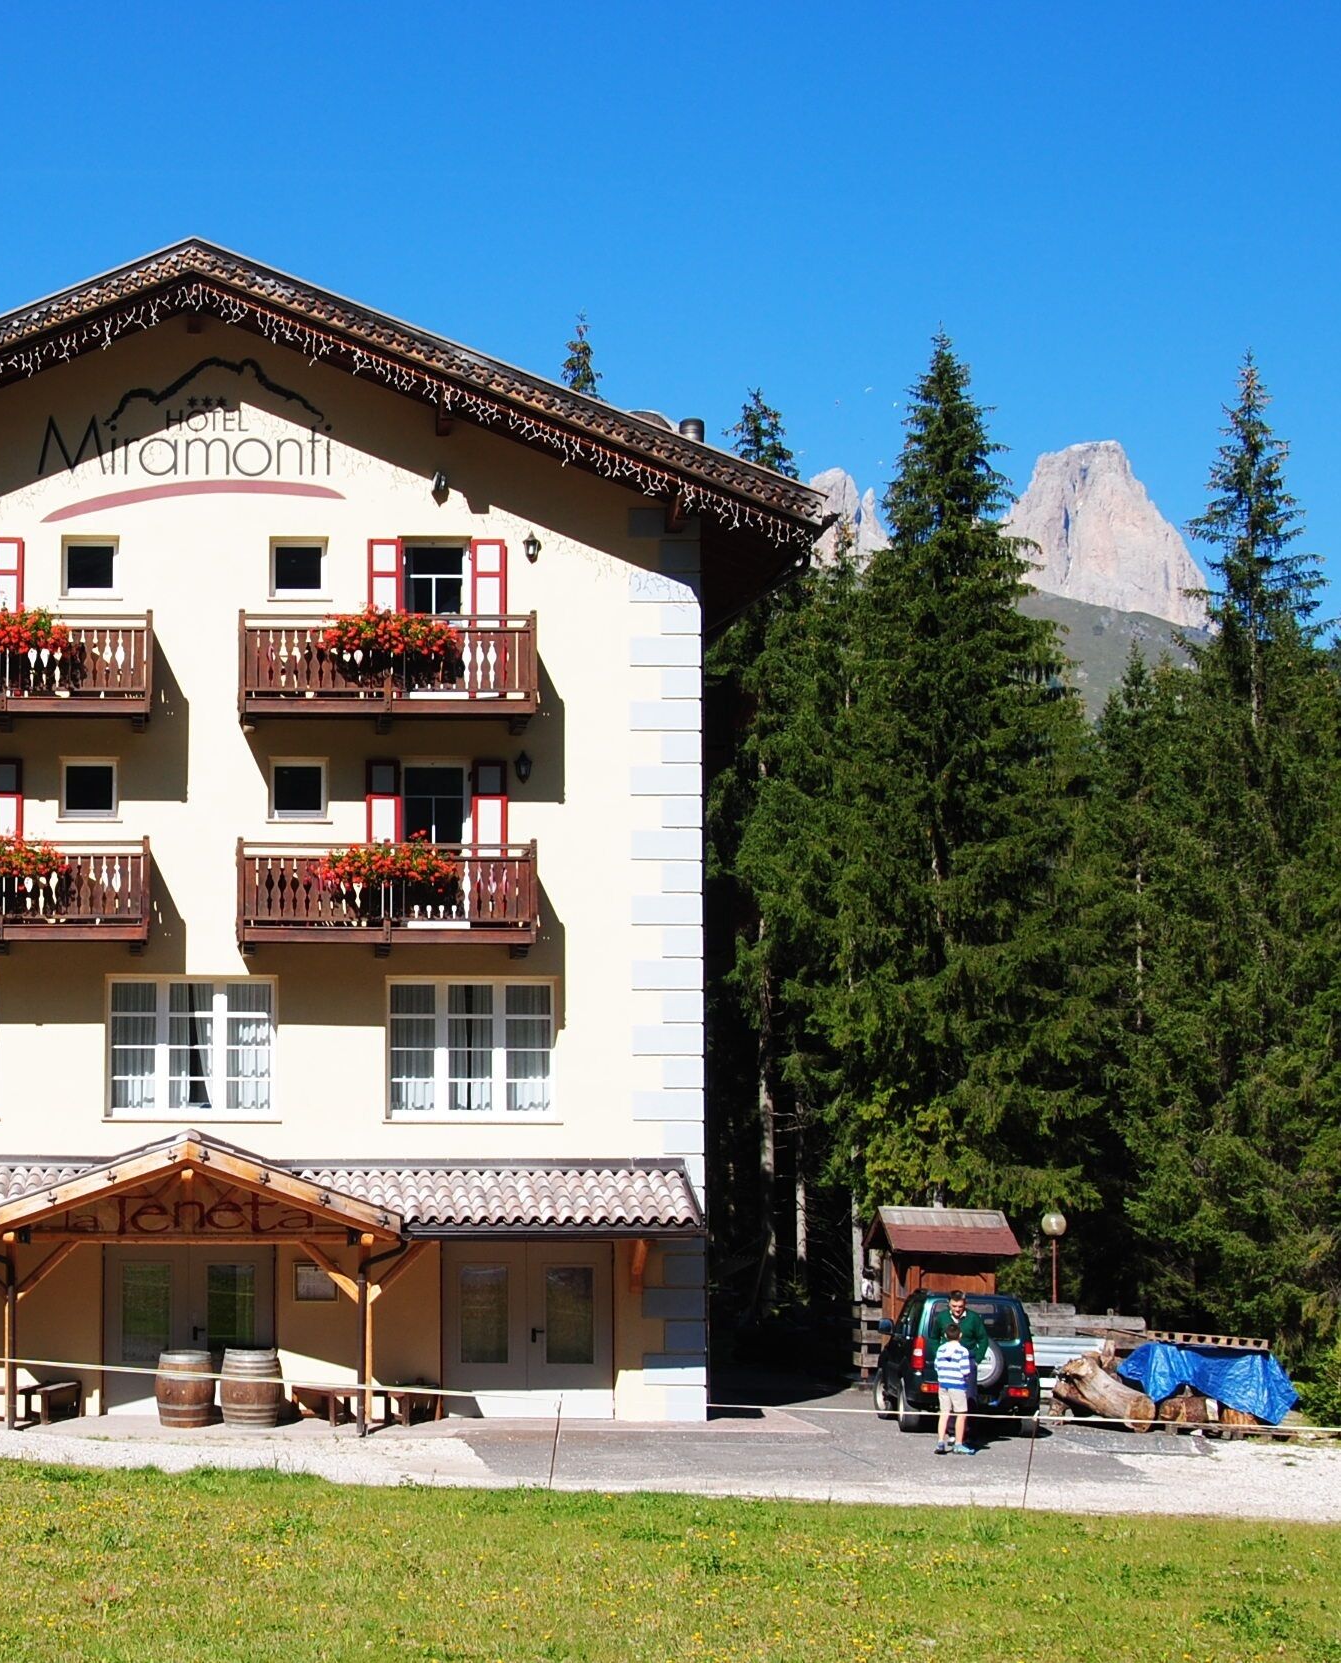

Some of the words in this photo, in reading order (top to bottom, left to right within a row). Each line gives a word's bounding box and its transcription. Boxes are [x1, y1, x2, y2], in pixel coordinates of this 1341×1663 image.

[166, 409, 249, 432] HOTEL
[38, 415, 332, 476] Miramonti
[108, 1192, 314, 1236] Teneta
